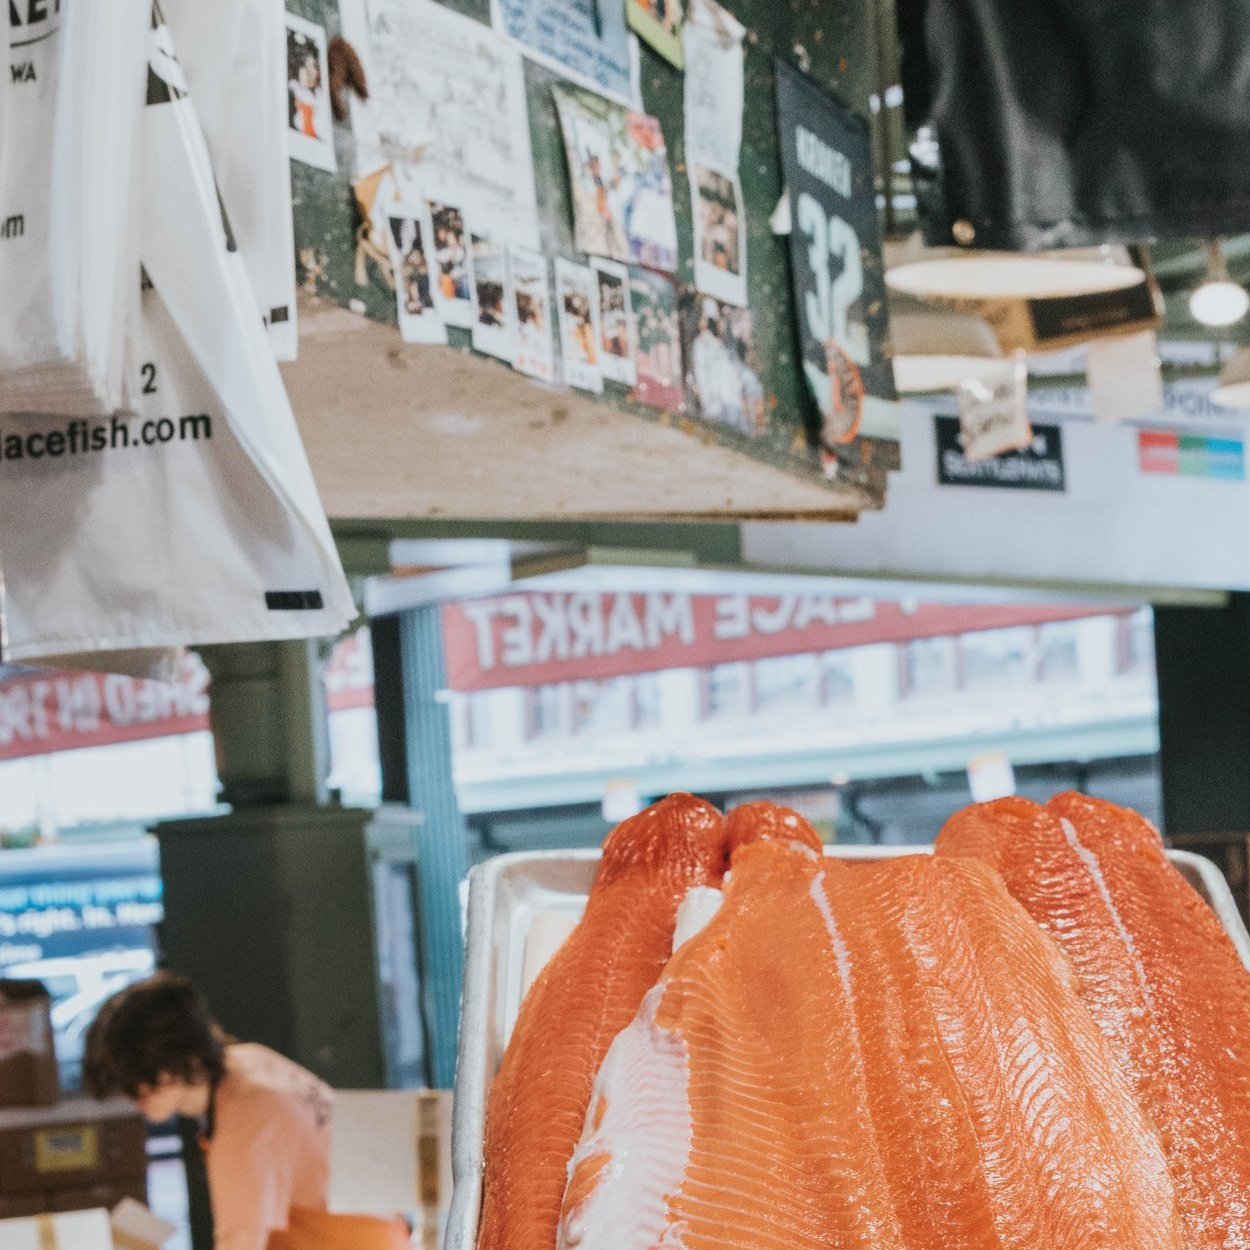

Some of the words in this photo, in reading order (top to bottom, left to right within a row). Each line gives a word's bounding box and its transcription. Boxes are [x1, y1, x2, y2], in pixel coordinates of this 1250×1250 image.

[10, 60, 36, 84] WA
[140, 362, 157, 394] 2
[0, 412, 212, 461] acefish.com
